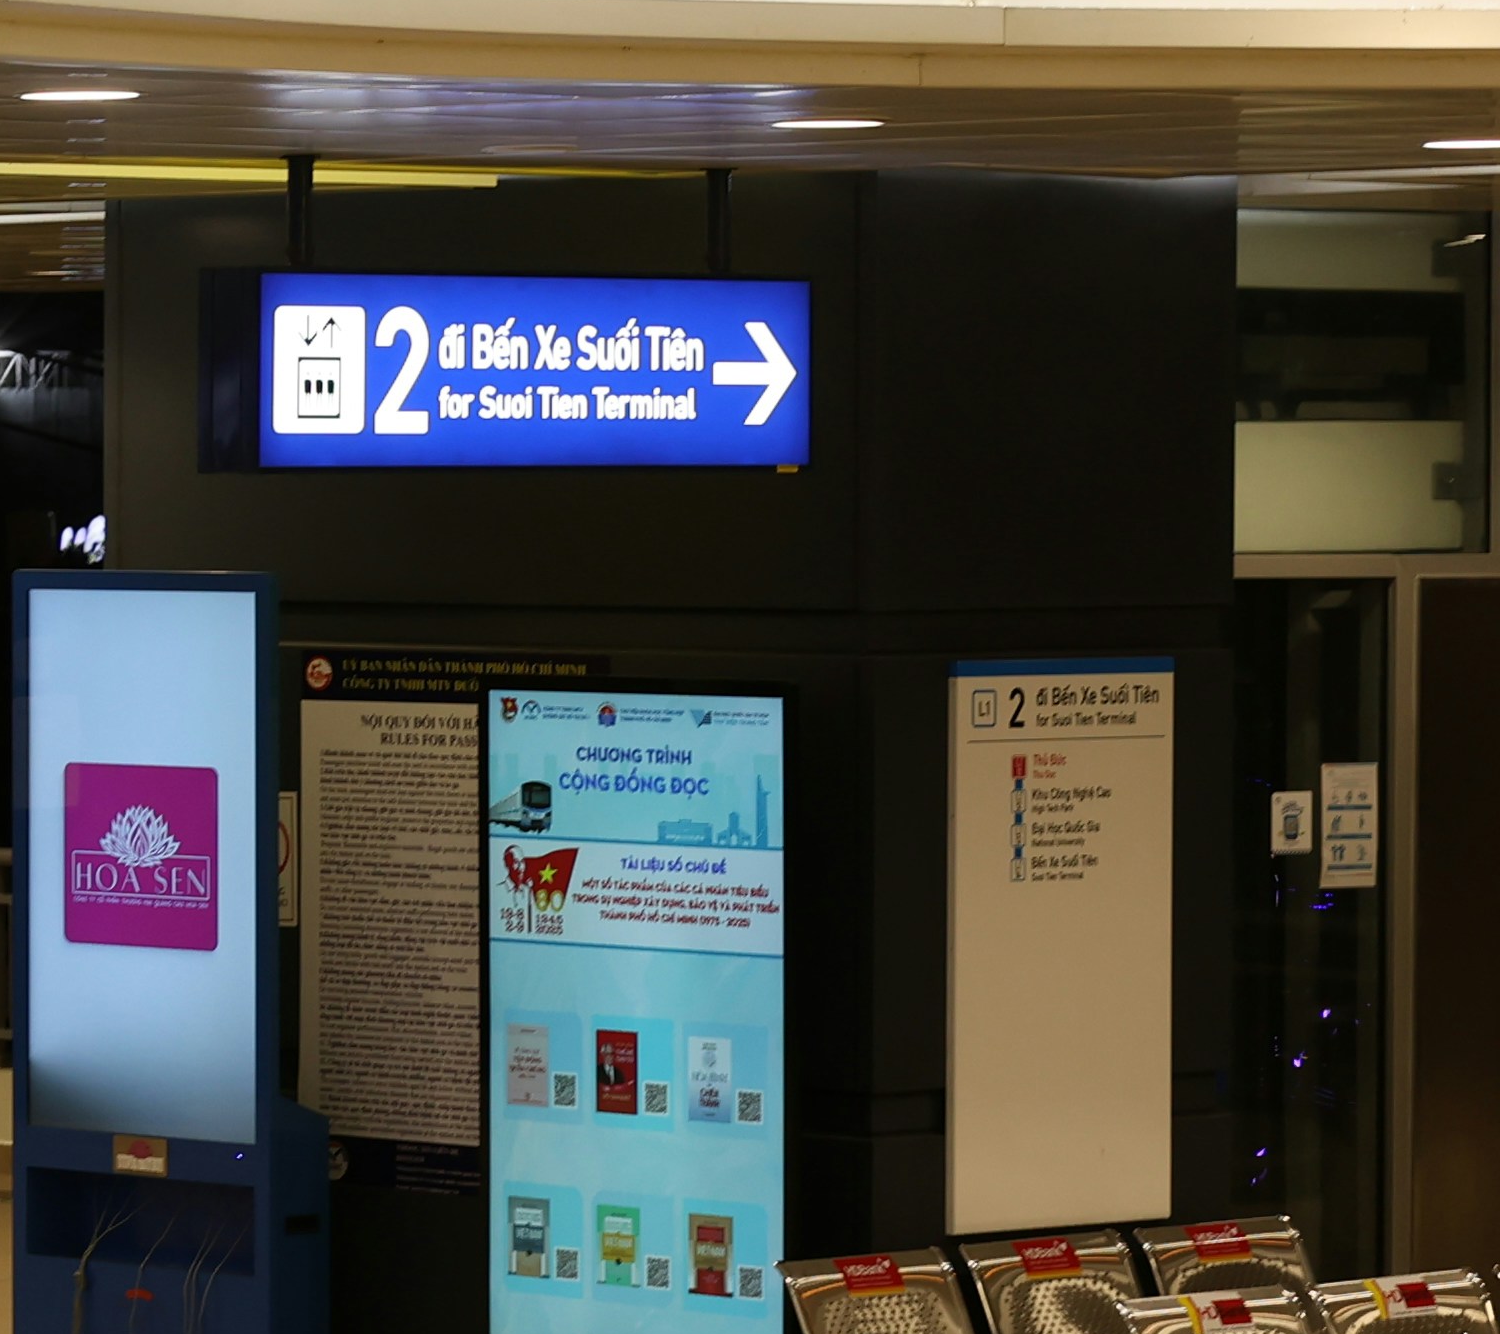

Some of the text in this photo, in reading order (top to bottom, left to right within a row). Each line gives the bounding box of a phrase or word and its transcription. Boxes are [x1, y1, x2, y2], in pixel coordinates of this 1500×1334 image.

[439, 317, 704, 372] đi Bến Xe Suối Tiên
[374, 305, 430, 435] 2
[439, 386, 696, 421] for Suoi Tien Terminal
[978, 700, 991, 717] L1
[1009, 687, 1025, 728] 2
[1036, 683, 1159, 706] đi Bến Xe Suối Tiên
[1036, 711, 1136, 726] for Suoi Tien Terminal
[381, 733, 447, 746] RULES FOR
[577, 745, 692, 765] CHƯƠNG TRÌNH
[559, 769, 610, 794] CỘNG
[671, 777, 709, 799] ĐỌC
[77, 863, 206, 895] HOA SEN
